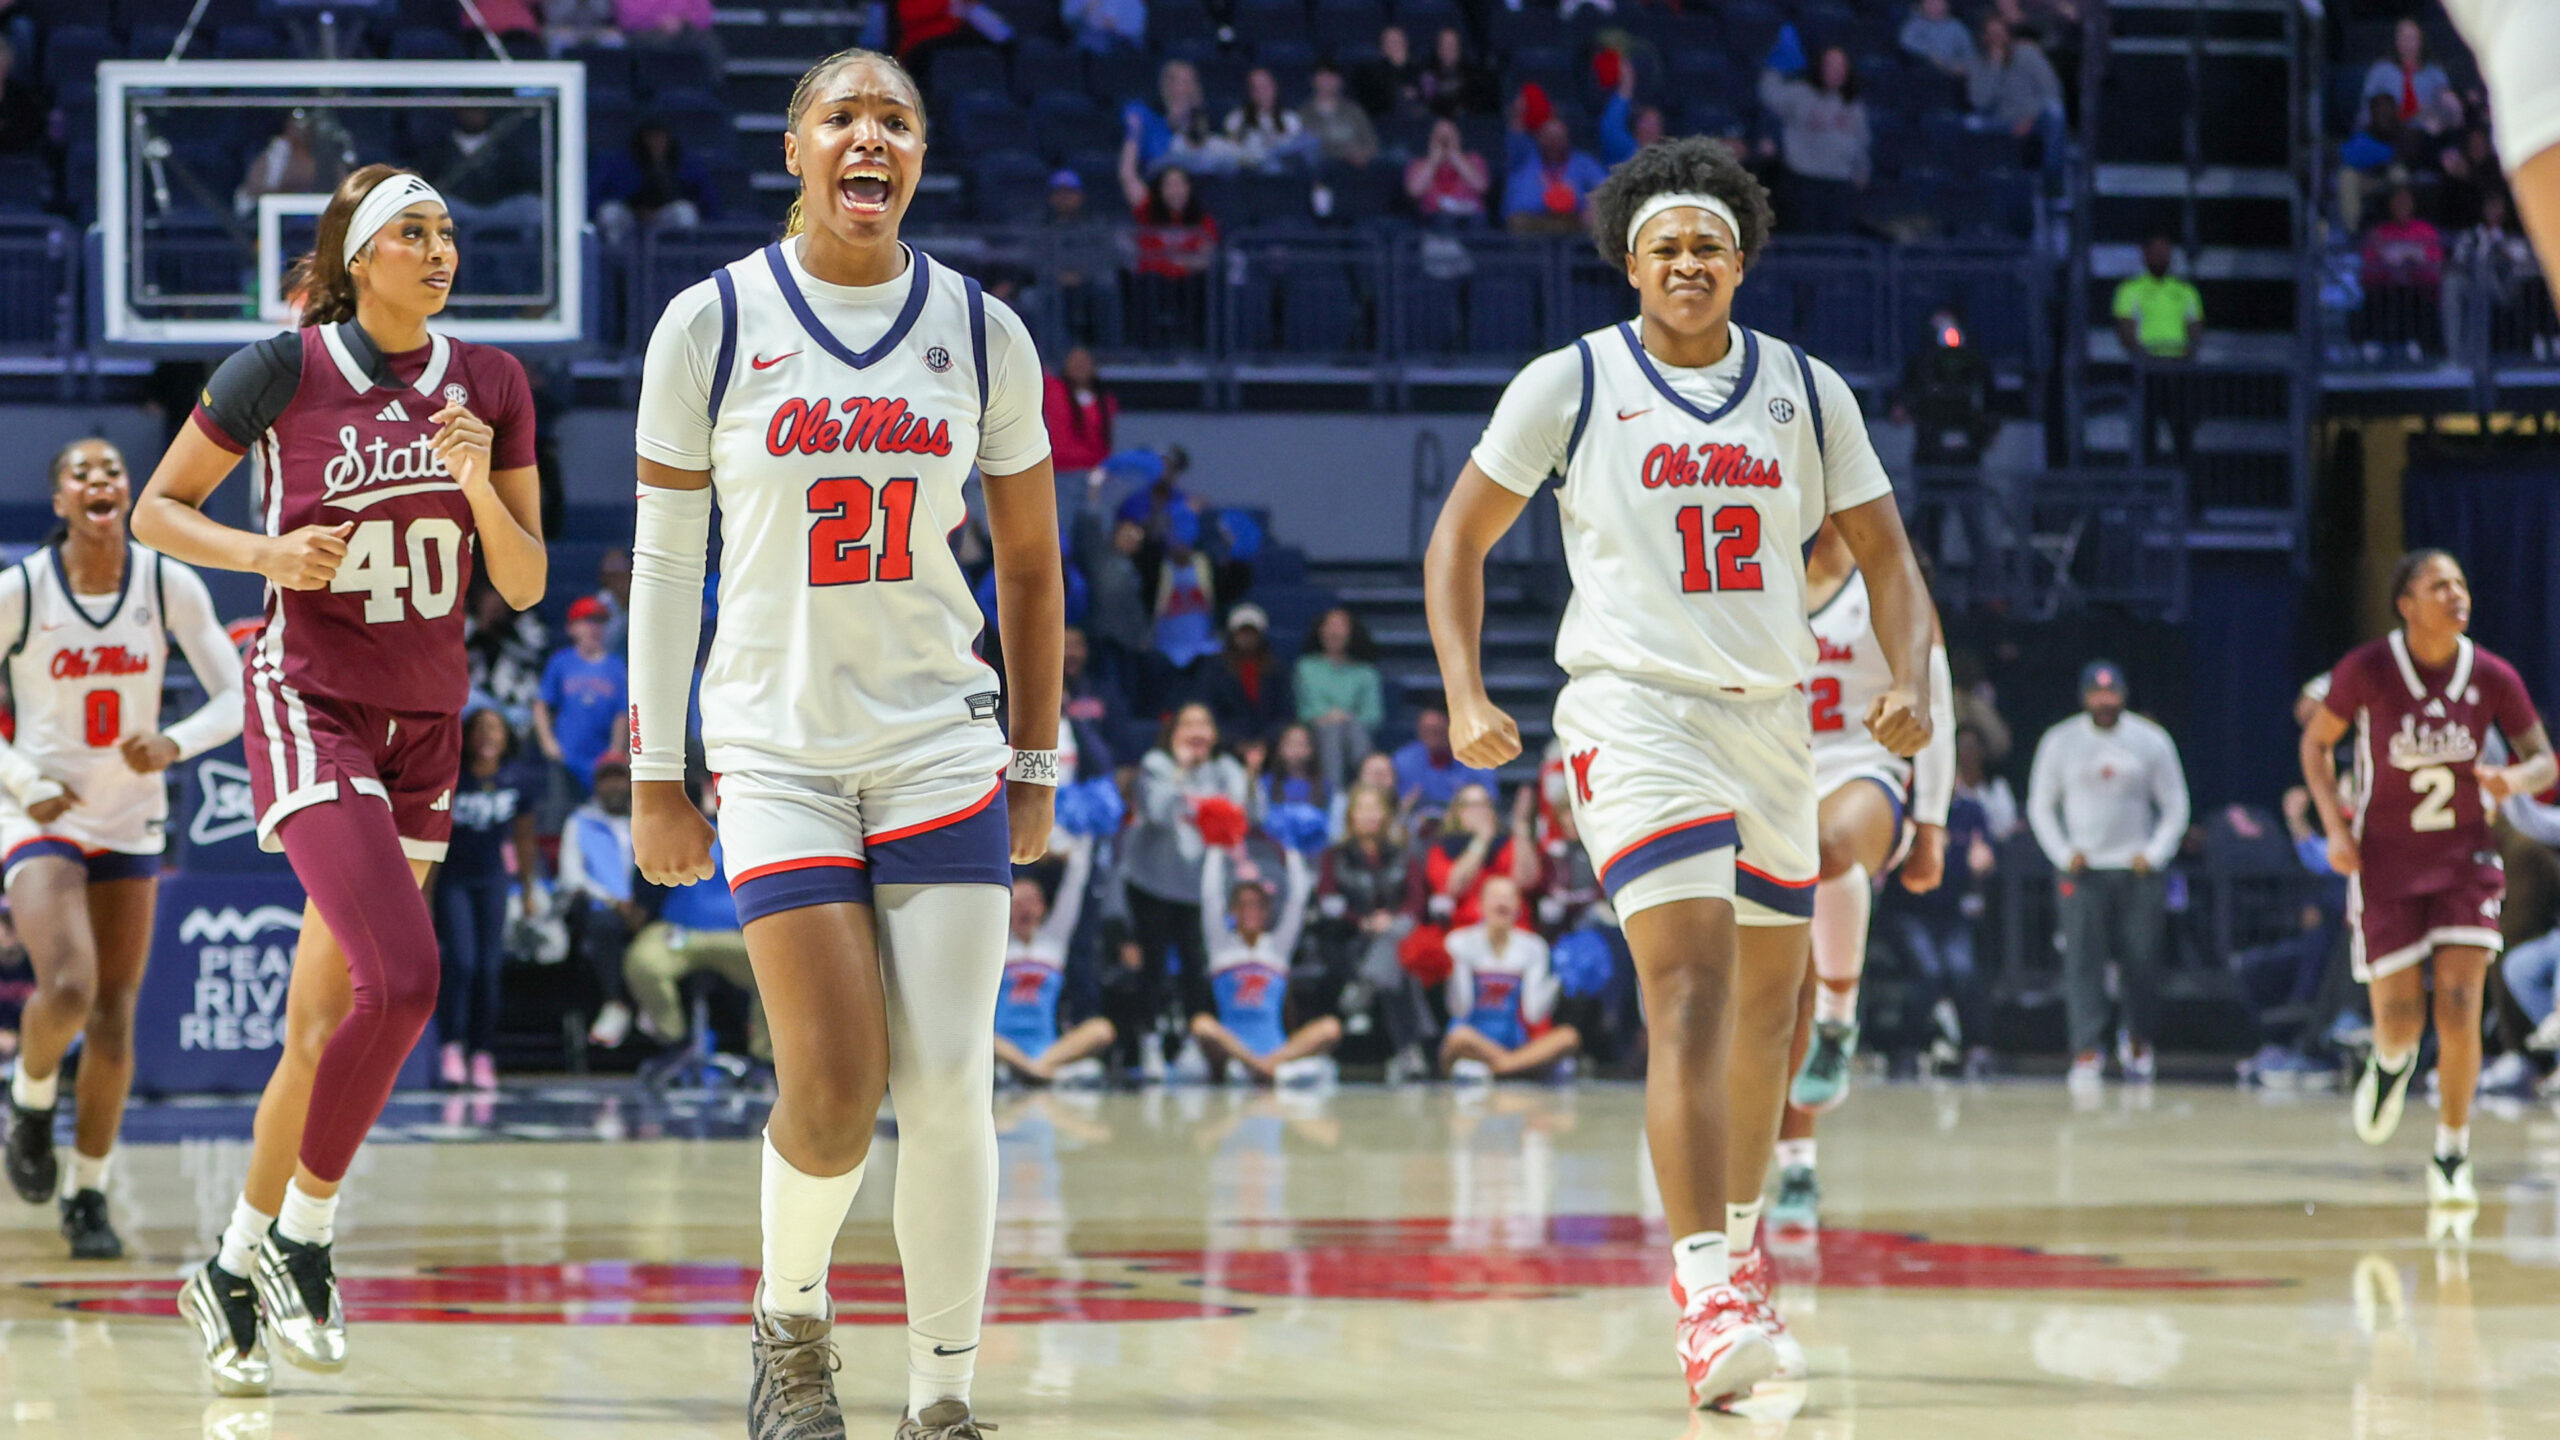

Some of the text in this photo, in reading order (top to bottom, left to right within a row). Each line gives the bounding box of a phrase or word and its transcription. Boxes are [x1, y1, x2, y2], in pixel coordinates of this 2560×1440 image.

[928, 348, 948, 367] SEC
[766, 396, 952, 457] Ole Miss
[1770, 399, 1792, 422] SEC
[1642, 443, 1782, 489] Ole Miss
[807, 476, 918, 587] 21
[1676, 505, 1763, 593] 12
[330, 518, 463, 624] 40
[85, 689, 121, 748] 0
[1794, 677, 1844, 732] 2
[2410, 765, 2456, 832] 2
[200, 945, 298, 981] PEA
[194, 977, 288, 1017] RIV
